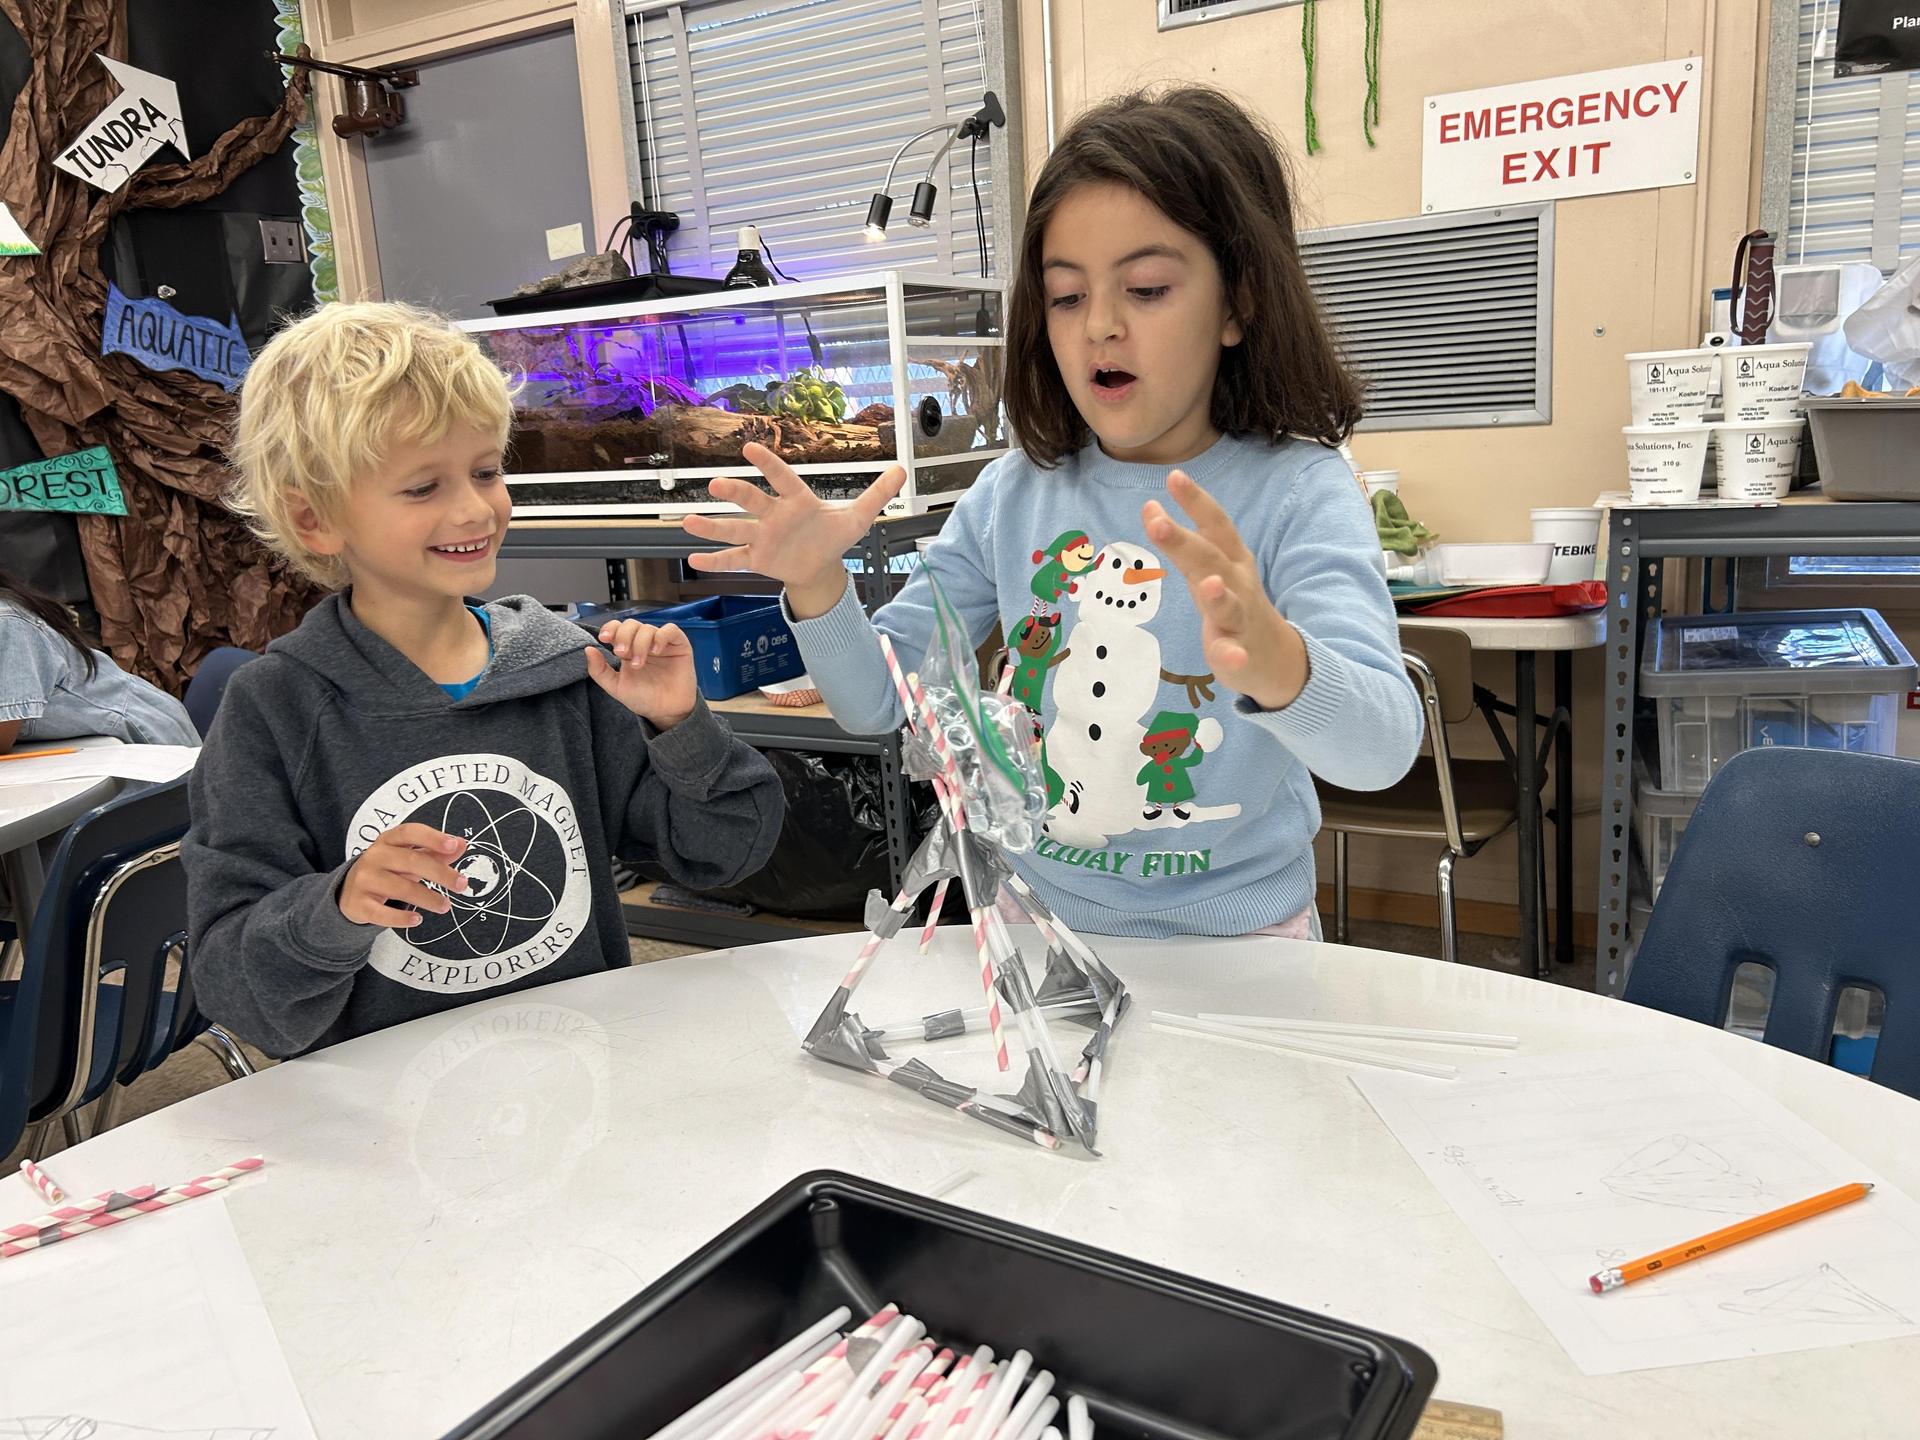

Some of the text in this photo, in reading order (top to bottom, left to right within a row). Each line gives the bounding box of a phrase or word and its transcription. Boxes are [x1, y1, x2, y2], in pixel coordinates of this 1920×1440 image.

[1439, 80, 1688, 144] EMERGENCY
[65, 97, 167, 179] TUNDRA
[1502, 141, 1611, 185] EXIT
[117, 304, 239, 378] AQUATIC
[1666, 367, 1689, 377] Aqua
[1755, 361, 1780, 371] Aqua
[1635, 442, 1675, 451] Solutions,
[1677, 440, 1693, 449] Inc.
[1767, 438, 1788, 447] Aqua
[397, 763, 510, 804] GIFTED
[518, 776, 588, 878] MAGNET
[464, 827, 473, 837] N
[1138, 849, 1212, 878] FUN
[480, 912, 487, 922] S
[399, 922, 574, 986] EXPLORERS
